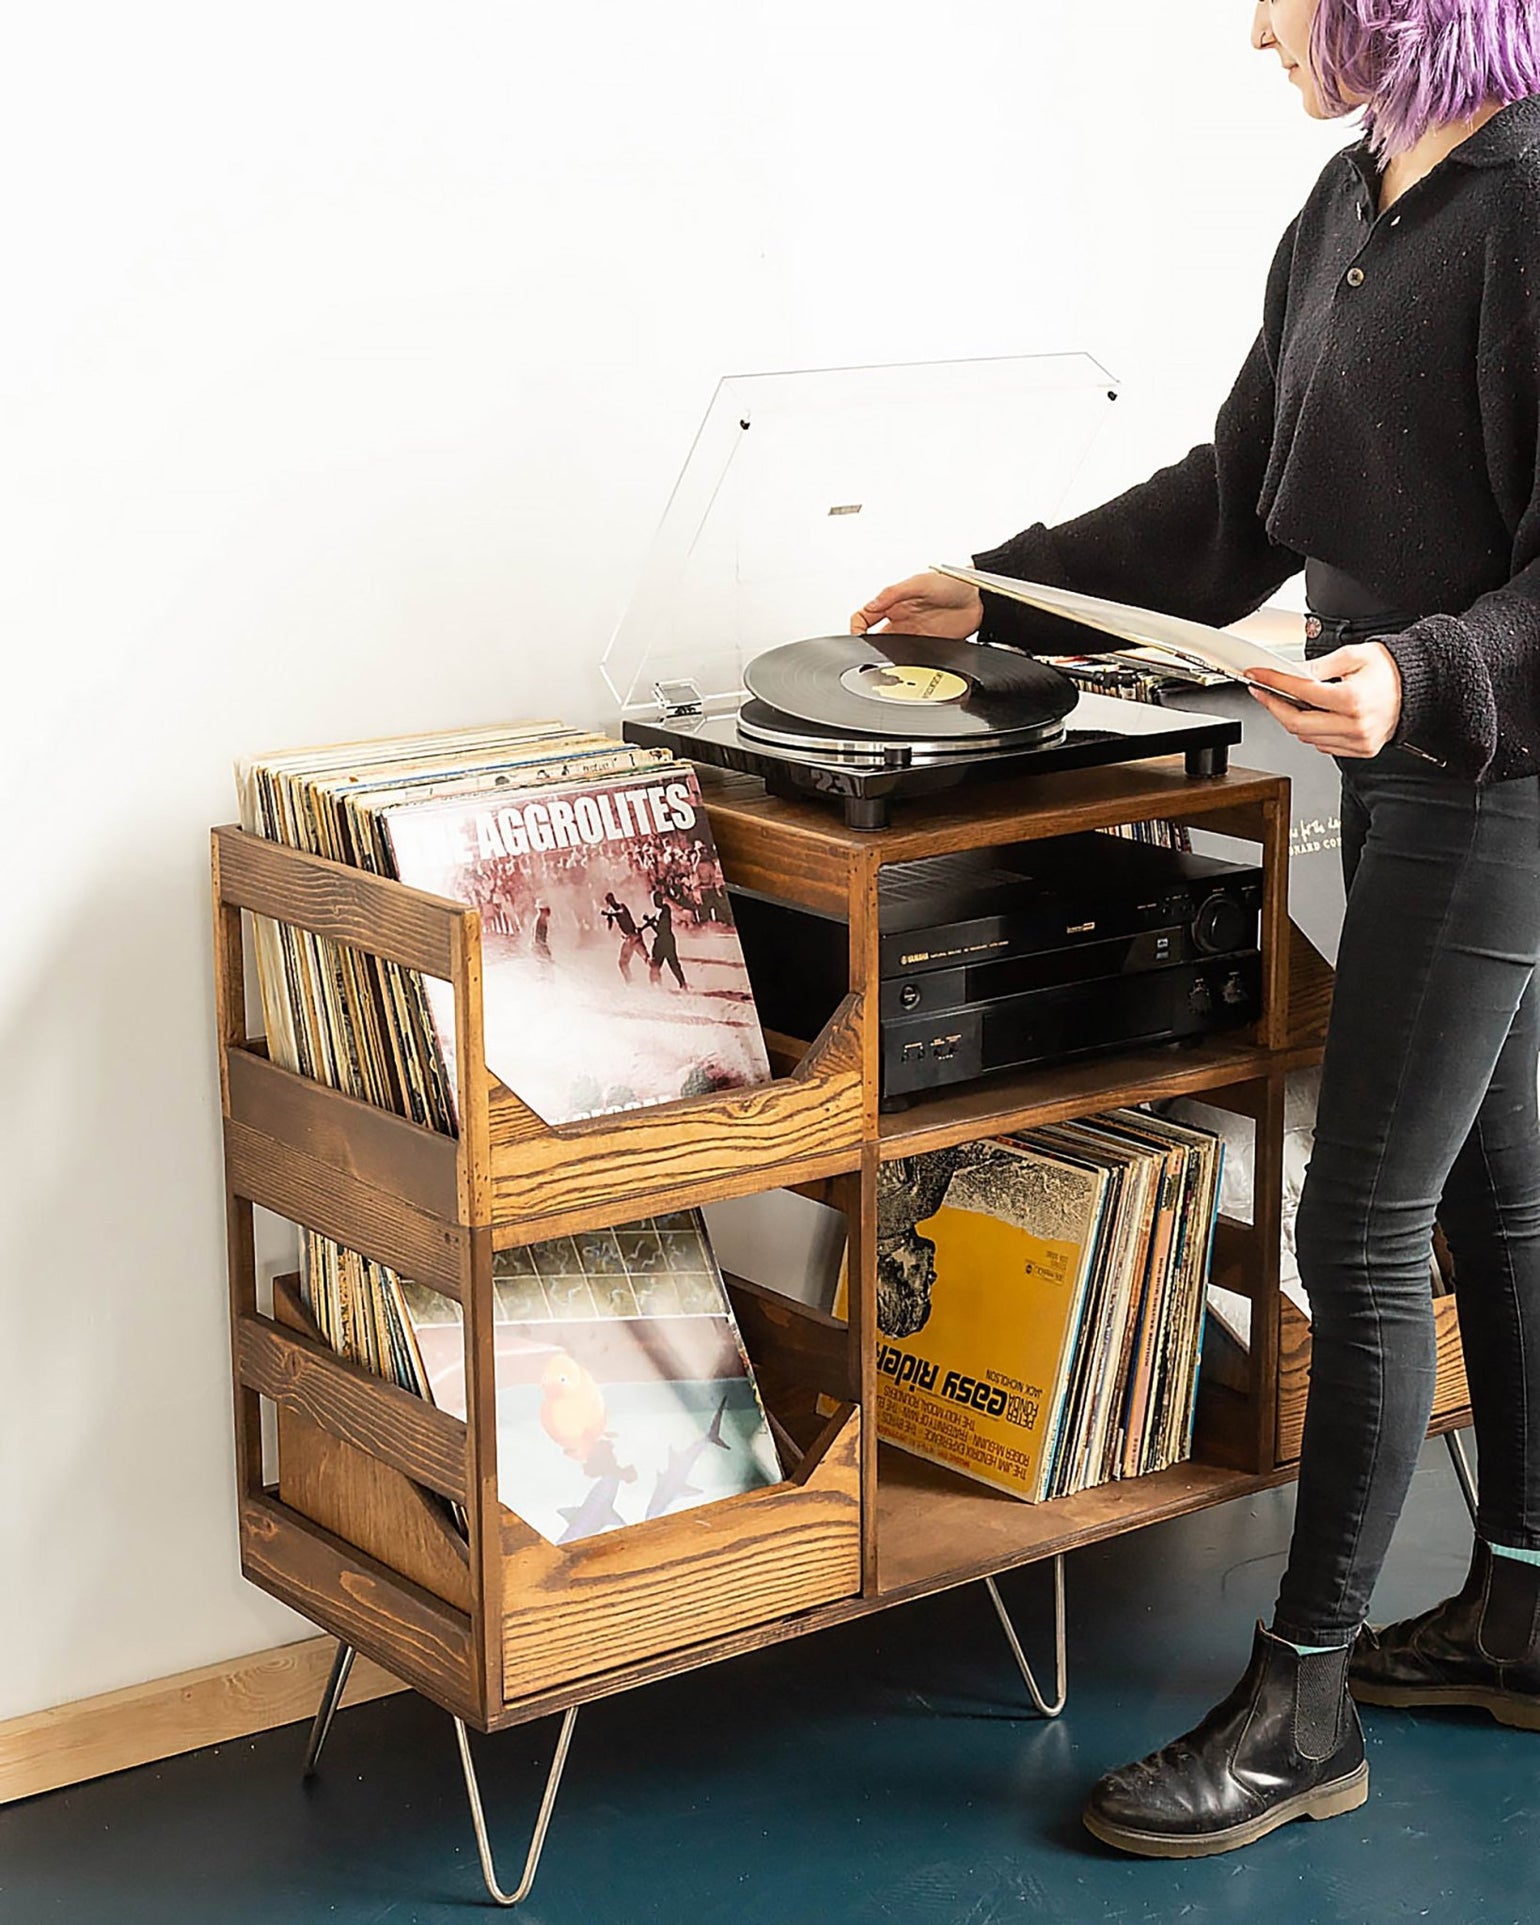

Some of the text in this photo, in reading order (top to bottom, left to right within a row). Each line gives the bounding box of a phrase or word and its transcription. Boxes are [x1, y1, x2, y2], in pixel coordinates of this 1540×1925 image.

[477, 783, 696, 860] AGGROLITES
[940, 1371, 1009, 1417] easy
[985, 1369, 1043, 1399] JACK NICHOLSON
[883, 1385, 920, 1408] ROUNDERS
[1007, 1394, 1039, 1417] FONDA
[944, 1410, 962, 1424] HOLY
[962, 1416, 975, 1431] THE
[1006, 1408, 1035, 1430] PETER
[924, 1429, 965, 1455] EXPERIENCE
[965, 1446, 997, 1468] HENDRIX
[1005, 1448, 1030, 1466] ROGER
